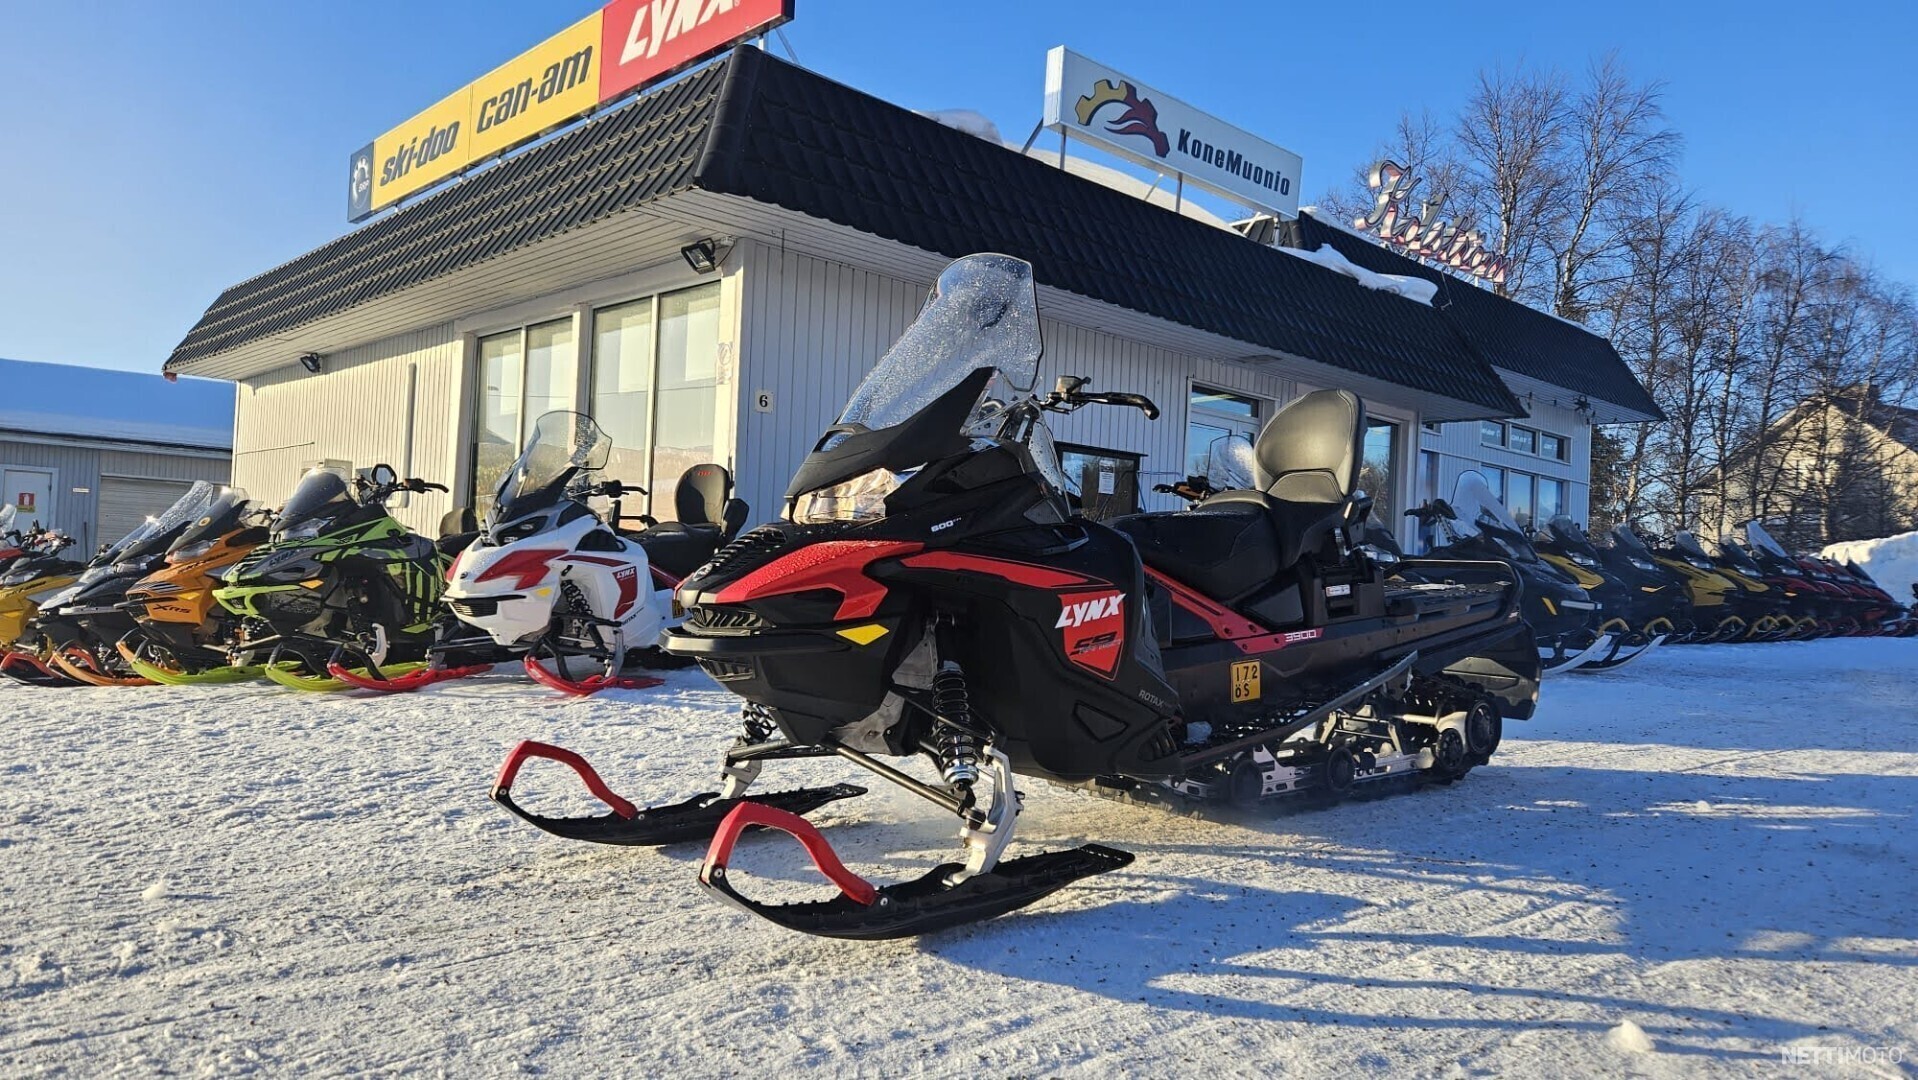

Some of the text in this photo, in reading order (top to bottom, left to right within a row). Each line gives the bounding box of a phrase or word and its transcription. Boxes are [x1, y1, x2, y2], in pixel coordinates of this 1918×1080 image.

[477, 45, 593, 134] can-am
[380, 121, 460, 187] ski-doo
[1178, 127, 1290, 197] KoneMuonio
[759, 394, 769, 408] 6
[1054, 593, 1127, 629] LYNX
[1284, 629, 1317, 642] 3900
[1236, 664, 1258, 682] 172
[1138, 689, 1164, 708] ROTAX
[1235, 682, 1250, 699] ÖS
